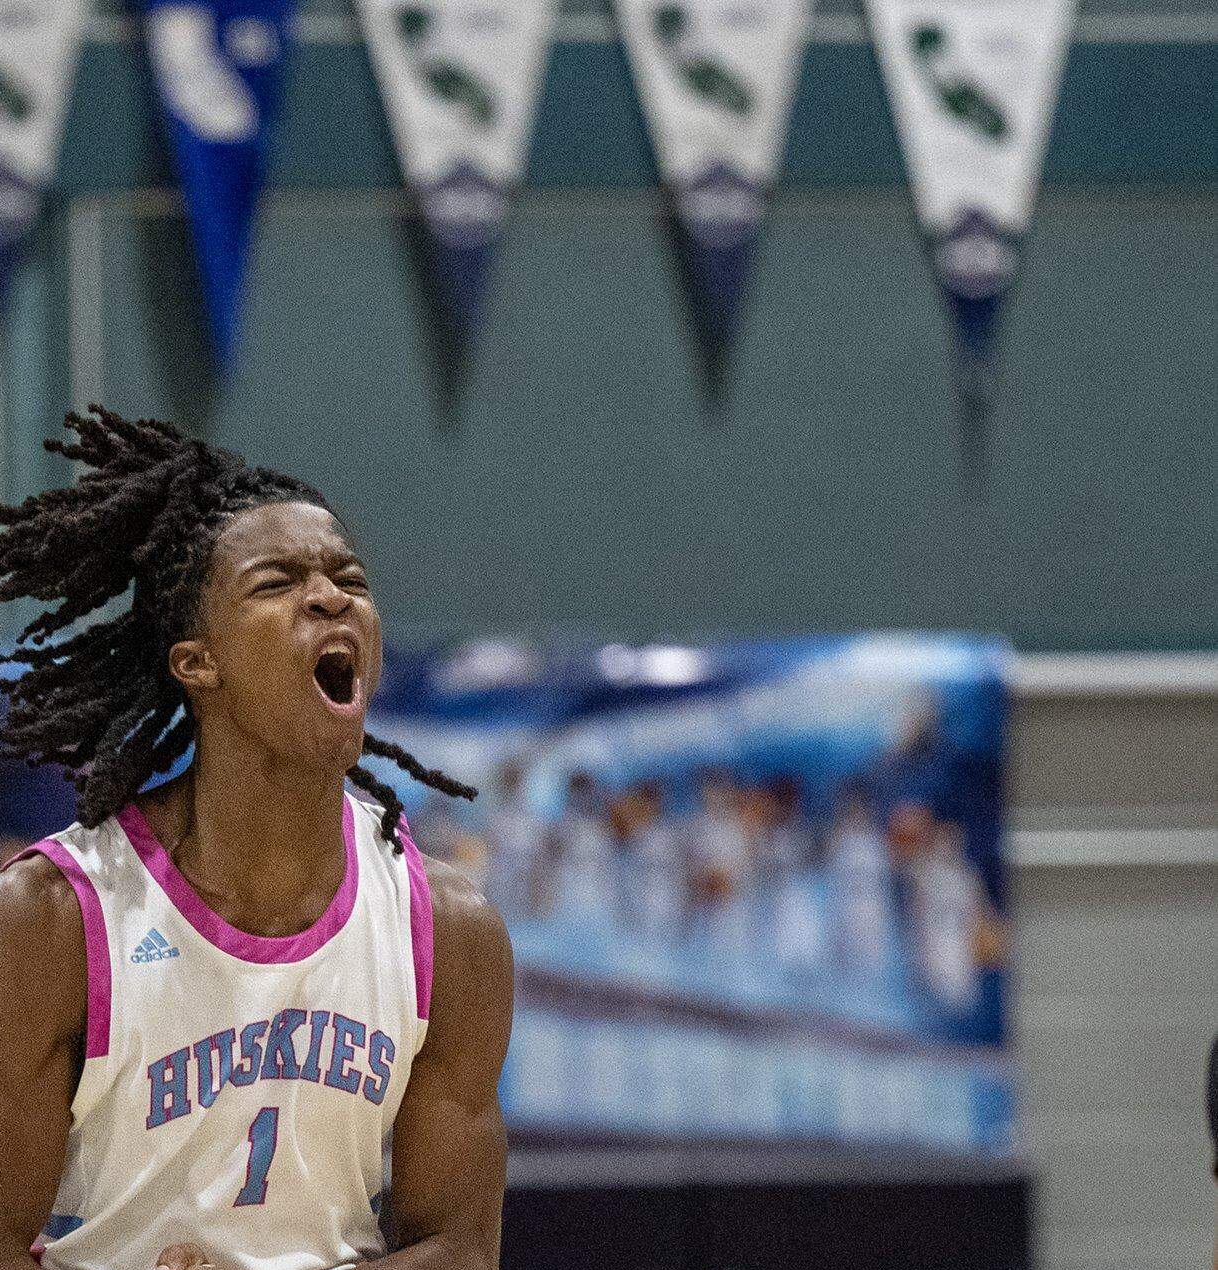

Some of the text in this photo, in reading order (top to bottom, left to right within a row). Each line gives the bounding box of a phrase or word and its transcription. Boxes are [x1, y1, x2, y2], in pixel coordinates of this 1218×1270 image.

[131, 947, 180, 963] adidas
[146, 1008, 396, 1131] HUSKIES
[232, 1106, 280, 1208] 1
